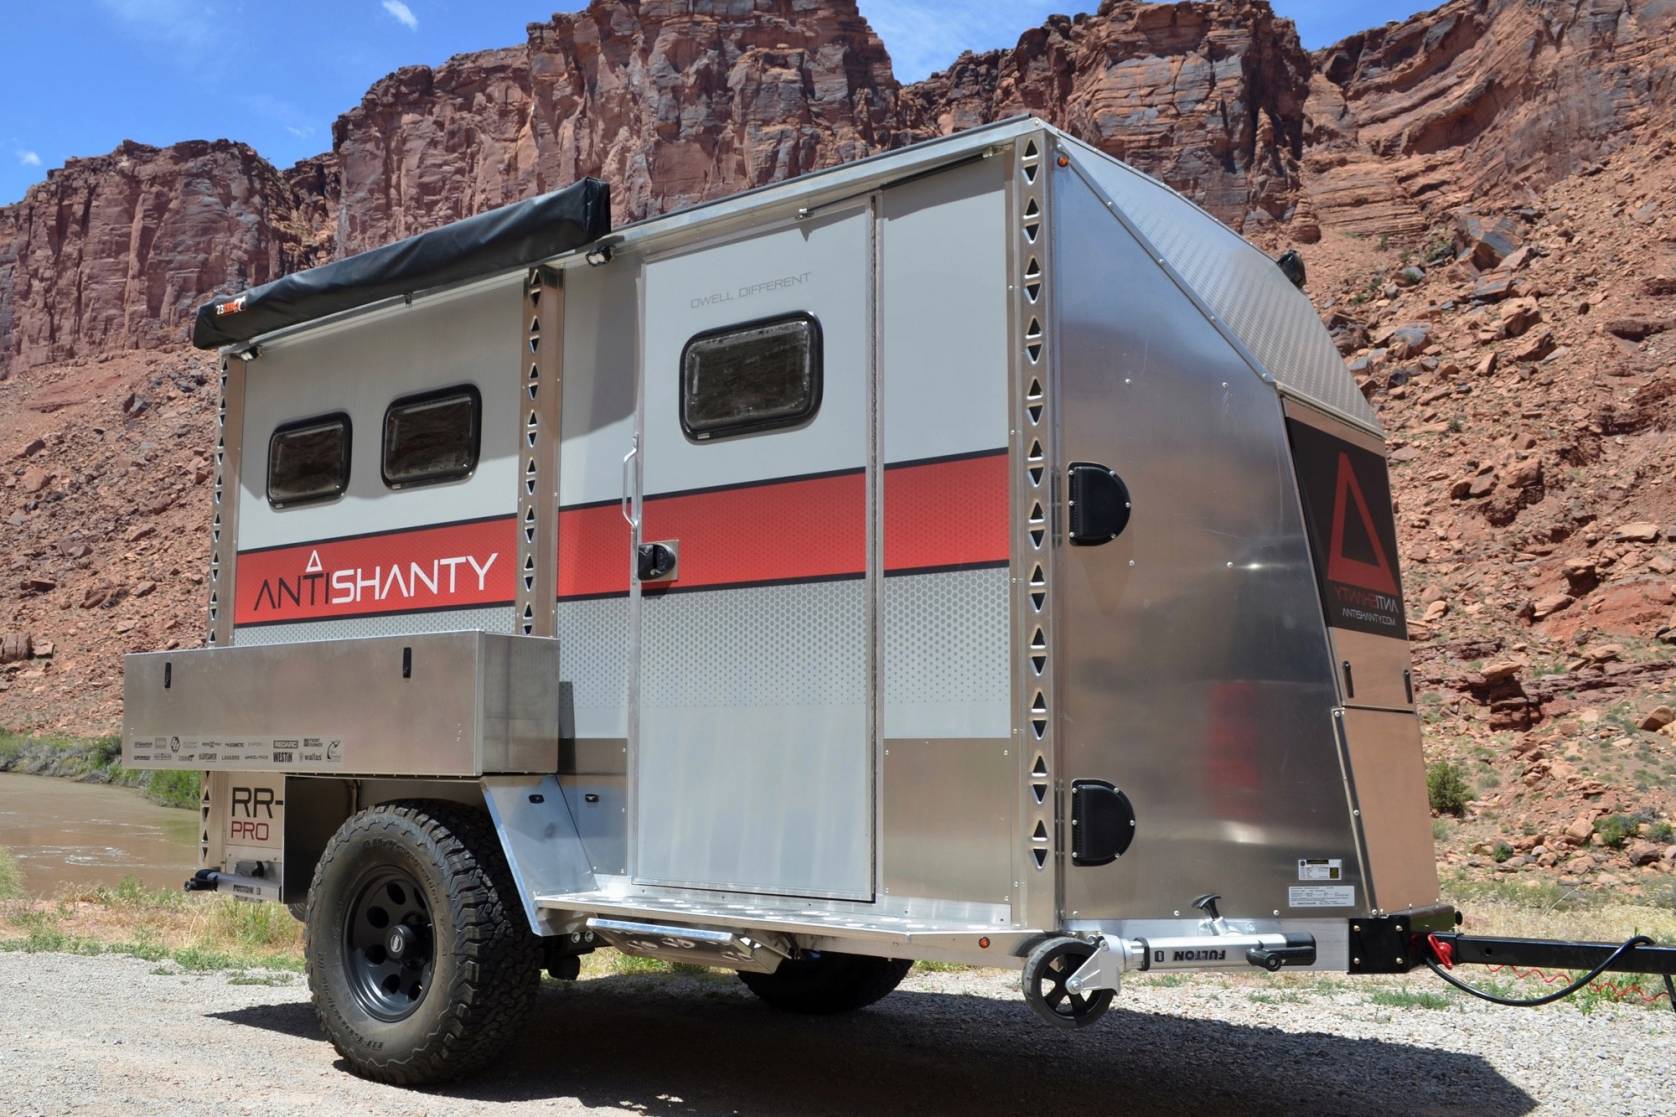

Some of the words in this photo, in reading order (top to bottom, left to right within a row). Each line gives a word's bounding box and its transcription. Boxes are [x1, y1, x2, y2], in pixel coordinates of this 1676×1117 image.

[738, 271, 813, 298] DIFFERENT
[254, 552, 499, 611] ANTISHANTY
[231, 821, 269, 841] PRO
[1173, 949, 1226, 962] FULTON
